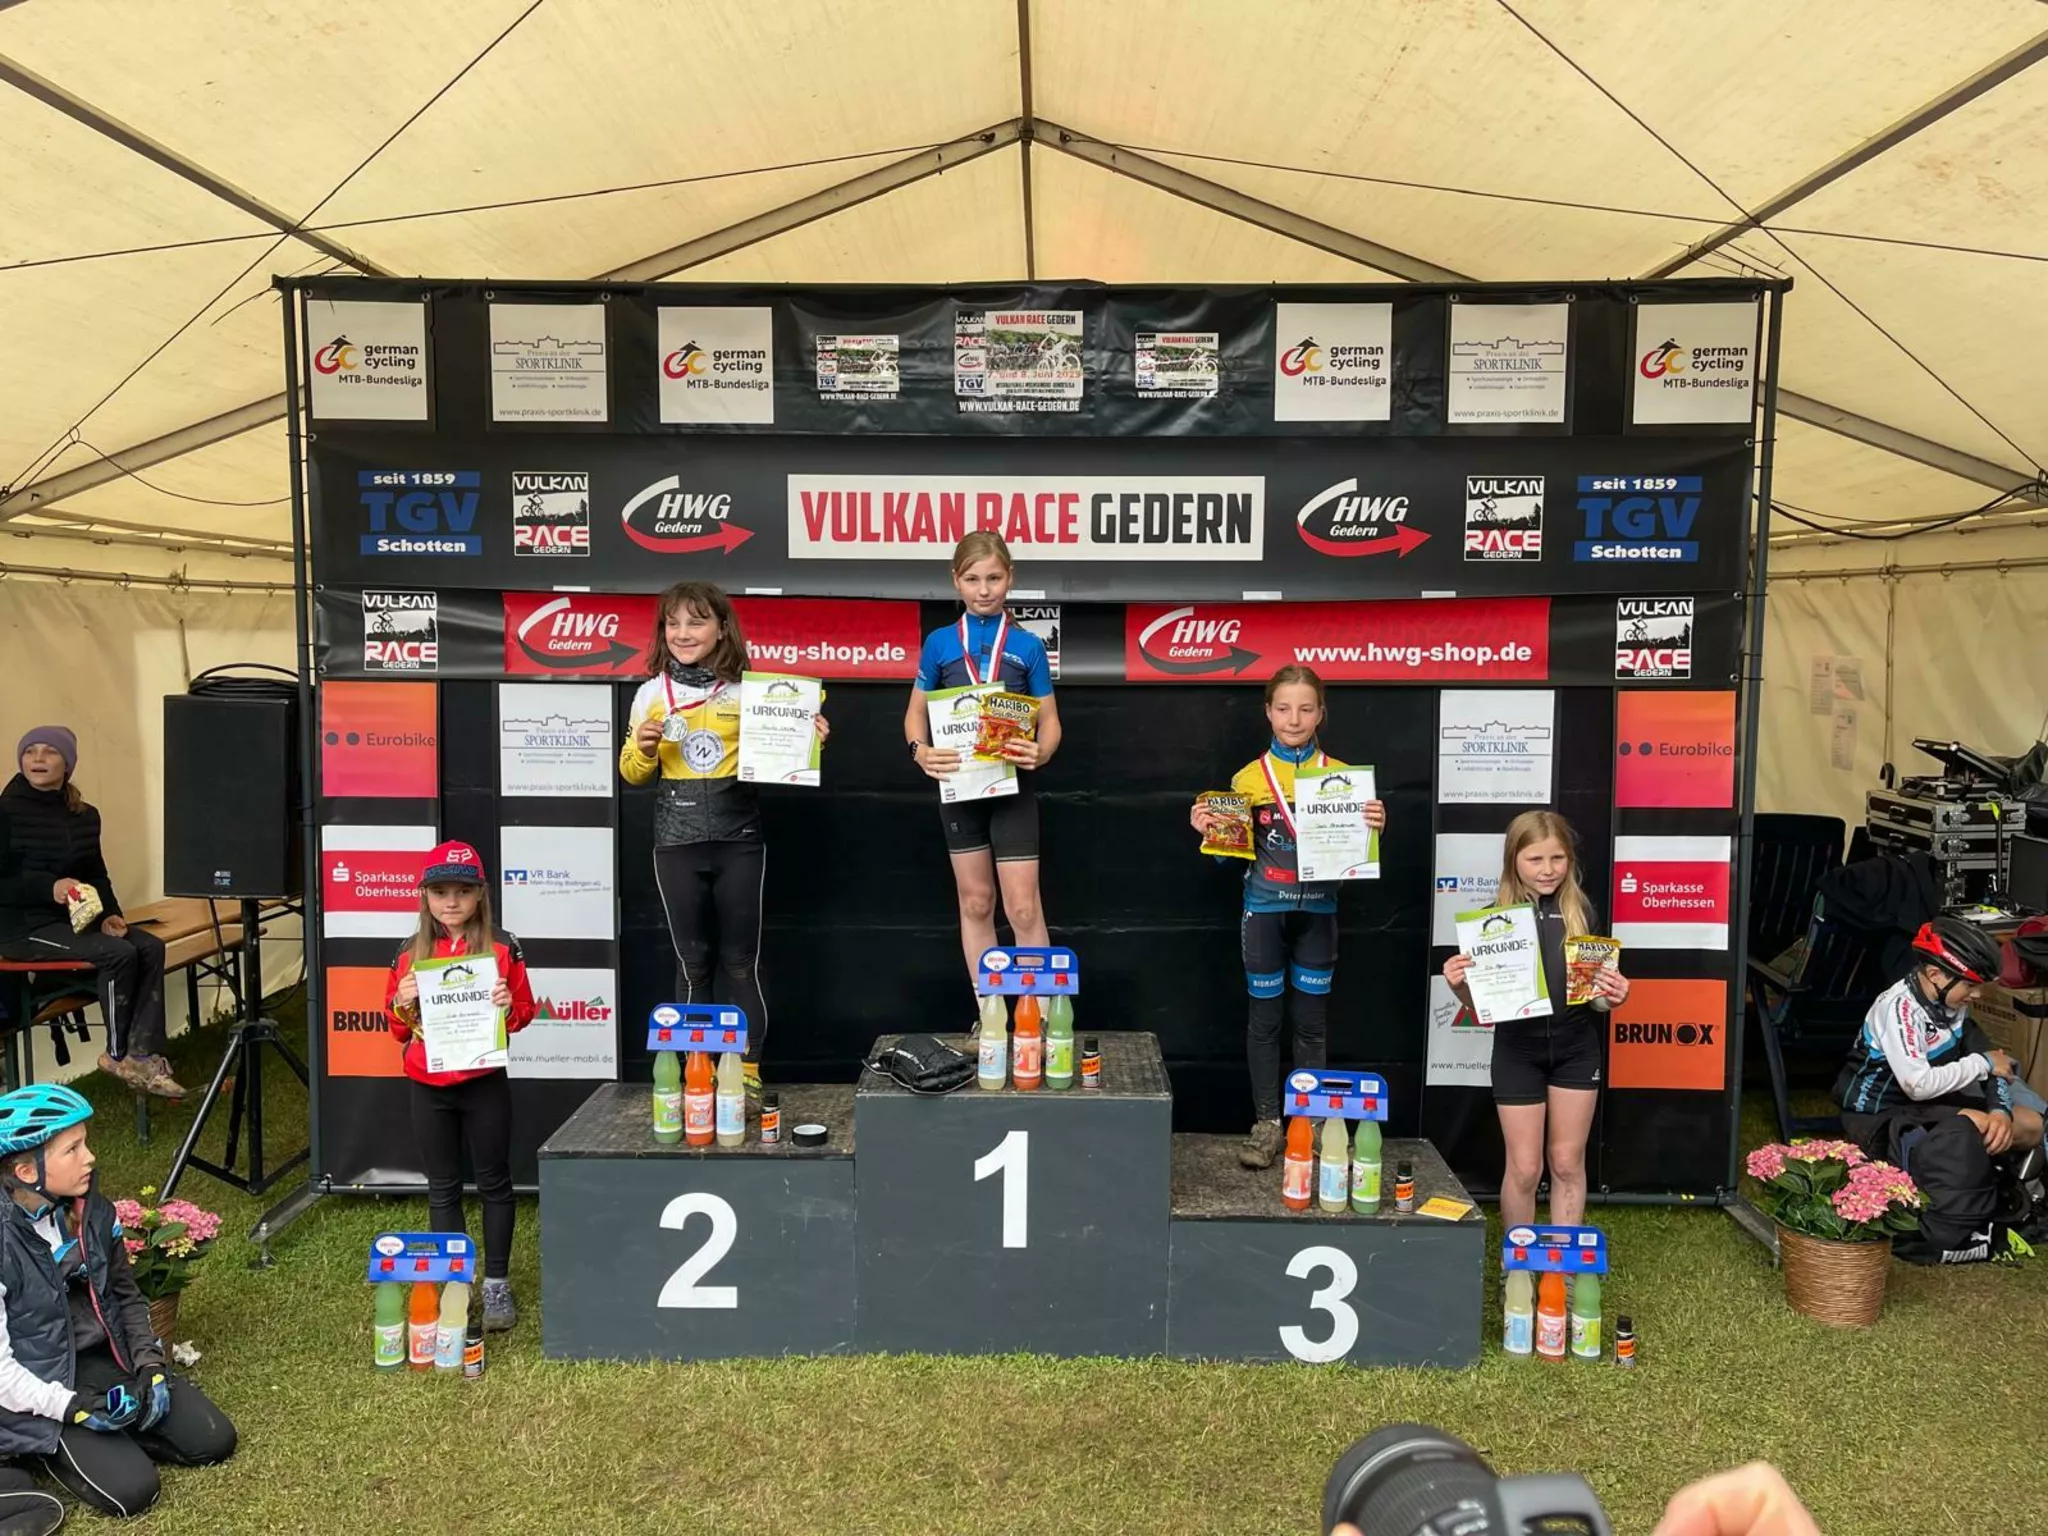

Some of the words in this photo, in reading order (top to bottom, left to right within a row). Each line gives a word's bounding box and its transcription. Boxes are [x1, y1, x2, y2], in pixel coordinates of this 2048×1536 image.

[996, 315, 1026, 324] VULKAN
[1026, 315, 1046, 324] RACE
[1046, 315, 1076, 324] GEDERN
[364, 342, 418, 356] german
[713, 348, 766, 362] german
[1331, 345, 1384, 359] german
[1693, 346, 1748, 360] german
[364, 355, 416, 370] cycling
[516, 358, 583, 370] SPORTKLINIK
[713, 360, 763, 374] cycling
[1331, 356, 1380, 371] cycling
[1474, 358, 1542, 370] SPORTKLINIK
[1693, 358, 1744, 372] cycling
[339, 375, 422, 387] MTB-Bundesliga
[686, 379, 769, 391] MTB-Bundesliga
[958, 379, 984, 388] TGV
[1303, 375, 1387, 388] MTB-Bundesliga
[1664, 378, 1749, 391] MTB-Bundesliga
[499, 408, 602, 416] www.praxis-sportklinik.de
[959, 401, 1080, 412] WWW.VULKAN-RACE-GEDERN.DE
[1454, 409, 1559, 418] www.praxis-sportklinik.de
[374, 473, 406, 485] seit
[412, 473, 456, 485] 1859
[514, 476, 588, 490] VULKAN
[1592, 478, 1626, 490] seit
[1632, 478, 1678, 490] 1859
[1468, 479, 1544, 495] VULKAN
[360, 492, 480, 532] TGV
[656, 494, 732, 520] HWG
[1332, 496, 1409, 522] HWG
[800, 491, 967, 544] VULKAN
[976, 492, 1079, 544] RACE
[1090, 493, 1253, 544] GEDERN
[1576, 496, 1700, 538] TGV
[654, 521, 702, 534] Gedern
[1330, 524, 1378, 538] Gedern
[514, 525, 590, 546] RACE
[1466, 529, 1542, 550] RACE
[377, 538, 466, 554] Schotten
[532, 546, 572, 554] GEDERN
[1591, 544, 1682, 559] Schotten
[1482, 550, 1522, 560] GEDERN
[363, 594, 436, 608] VULKAN
[1618, 600, 1693, 616] VULKAN
[1012, 608, 1059, 620] LKAN
[551, 612, 619, 638] HWG
[1171, 620, 1241, 644] HWG
[364, 641, 436, 662] RACE
[548, 640, 592, 652] Gedern
[745, 640, 906, 664] hwg-shop.de
[1169, 646, 1214, 660] Gedern
[1294, 642, 1532, 666] www.hwg-shop.de
[1616, 649, 1690, 670] RACE
[382, 660, 420, 668] GEDERN
[1633, 669, 1672, 677] GEDERN
[990, 696, 1030, 714] HARIBO
[752, 704, 810, 721] URKUNDE
[943, 720, 979, 736] URKU
[366, 732, 436, 747] Eurobike
[524, 735, 590, 747] SPORTKLINIK
[1462, 741, 1528, 754] SPORTKLINIK
[1659, 743, 1734, 756] Eurobike
[508, 783, 608, 792] www.praxis-sportklinik.de
[1444, 790, 1545, 799] www.praxis-sportklinik.de
[1307, 802, 1366, 816] URKUNDE
[354, 871, 415, 884] Sparkasse
[530, 870, 544, 878] VR
[546, 870, 570, 878] Bank
[1460, 878, 1474, 886] VR
[1477, 877, 1500, 886] Bank
[1642, 882, 1704, 894] Sparkasse
[356, 886, 426, 898] Oberhessen
[1642, 896, 1715, 908] Oberhessen
[1472, 939, 1528, 956] URKUNDE
[1578, 942, 1614, 952] HARIBO
[431, 990, 491, 1006] URKUNDE
[533, 995, 612, 1020] Müller
[333, 1010, 388, 1032] BRUN
[1614, 1023, 1714, 1046] BRUNOX
[510, 1055, 614, 1064] www.mueller-mobil.de
[1431, 1062, 1492, 1070] www.mueller
[974, 1131, 1028, 1248] 1
[657, 1192, 738, 1308] 2
[1278, 1246, 1360, 1364] 3
